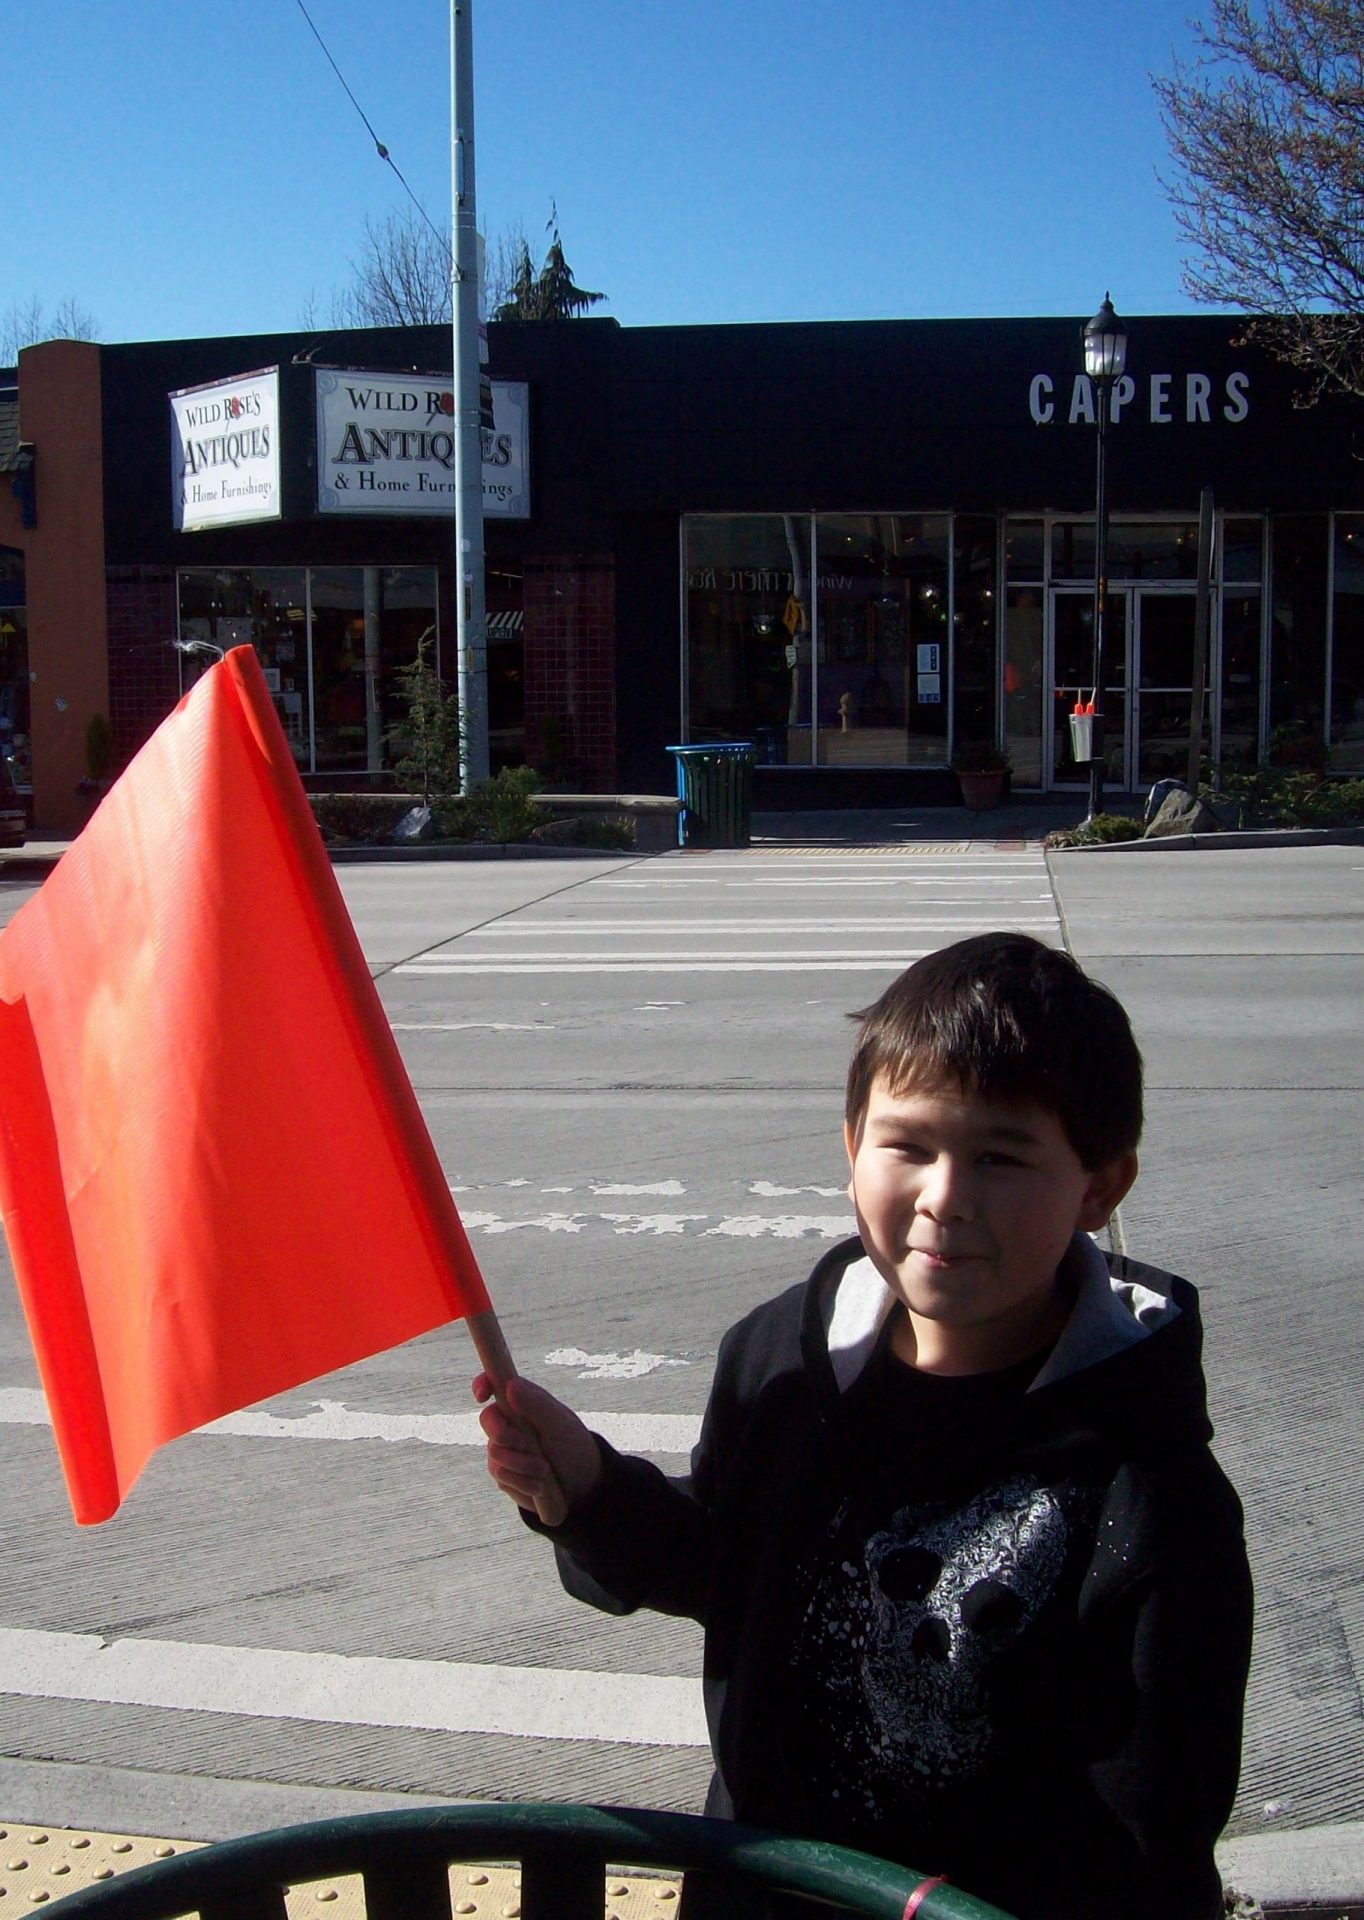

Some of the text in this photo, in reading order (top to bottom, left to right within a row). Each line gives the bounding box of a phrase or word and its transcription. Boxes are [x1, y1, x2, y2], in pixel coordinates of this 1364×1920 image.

[345, 387, 418, 411] WILD
[1029, 372, 1249, 424] CAPERS
[186, 403, 221, 428] WILD
[180, 425, 270, 476] ANTIQUES
[331, 421, 512, 470] ANTIQES
[192, 484, 218, 503] Home
[221, 476, 272, 499] Furnishings
[335, 470, 513, 501] & Home Furnings
